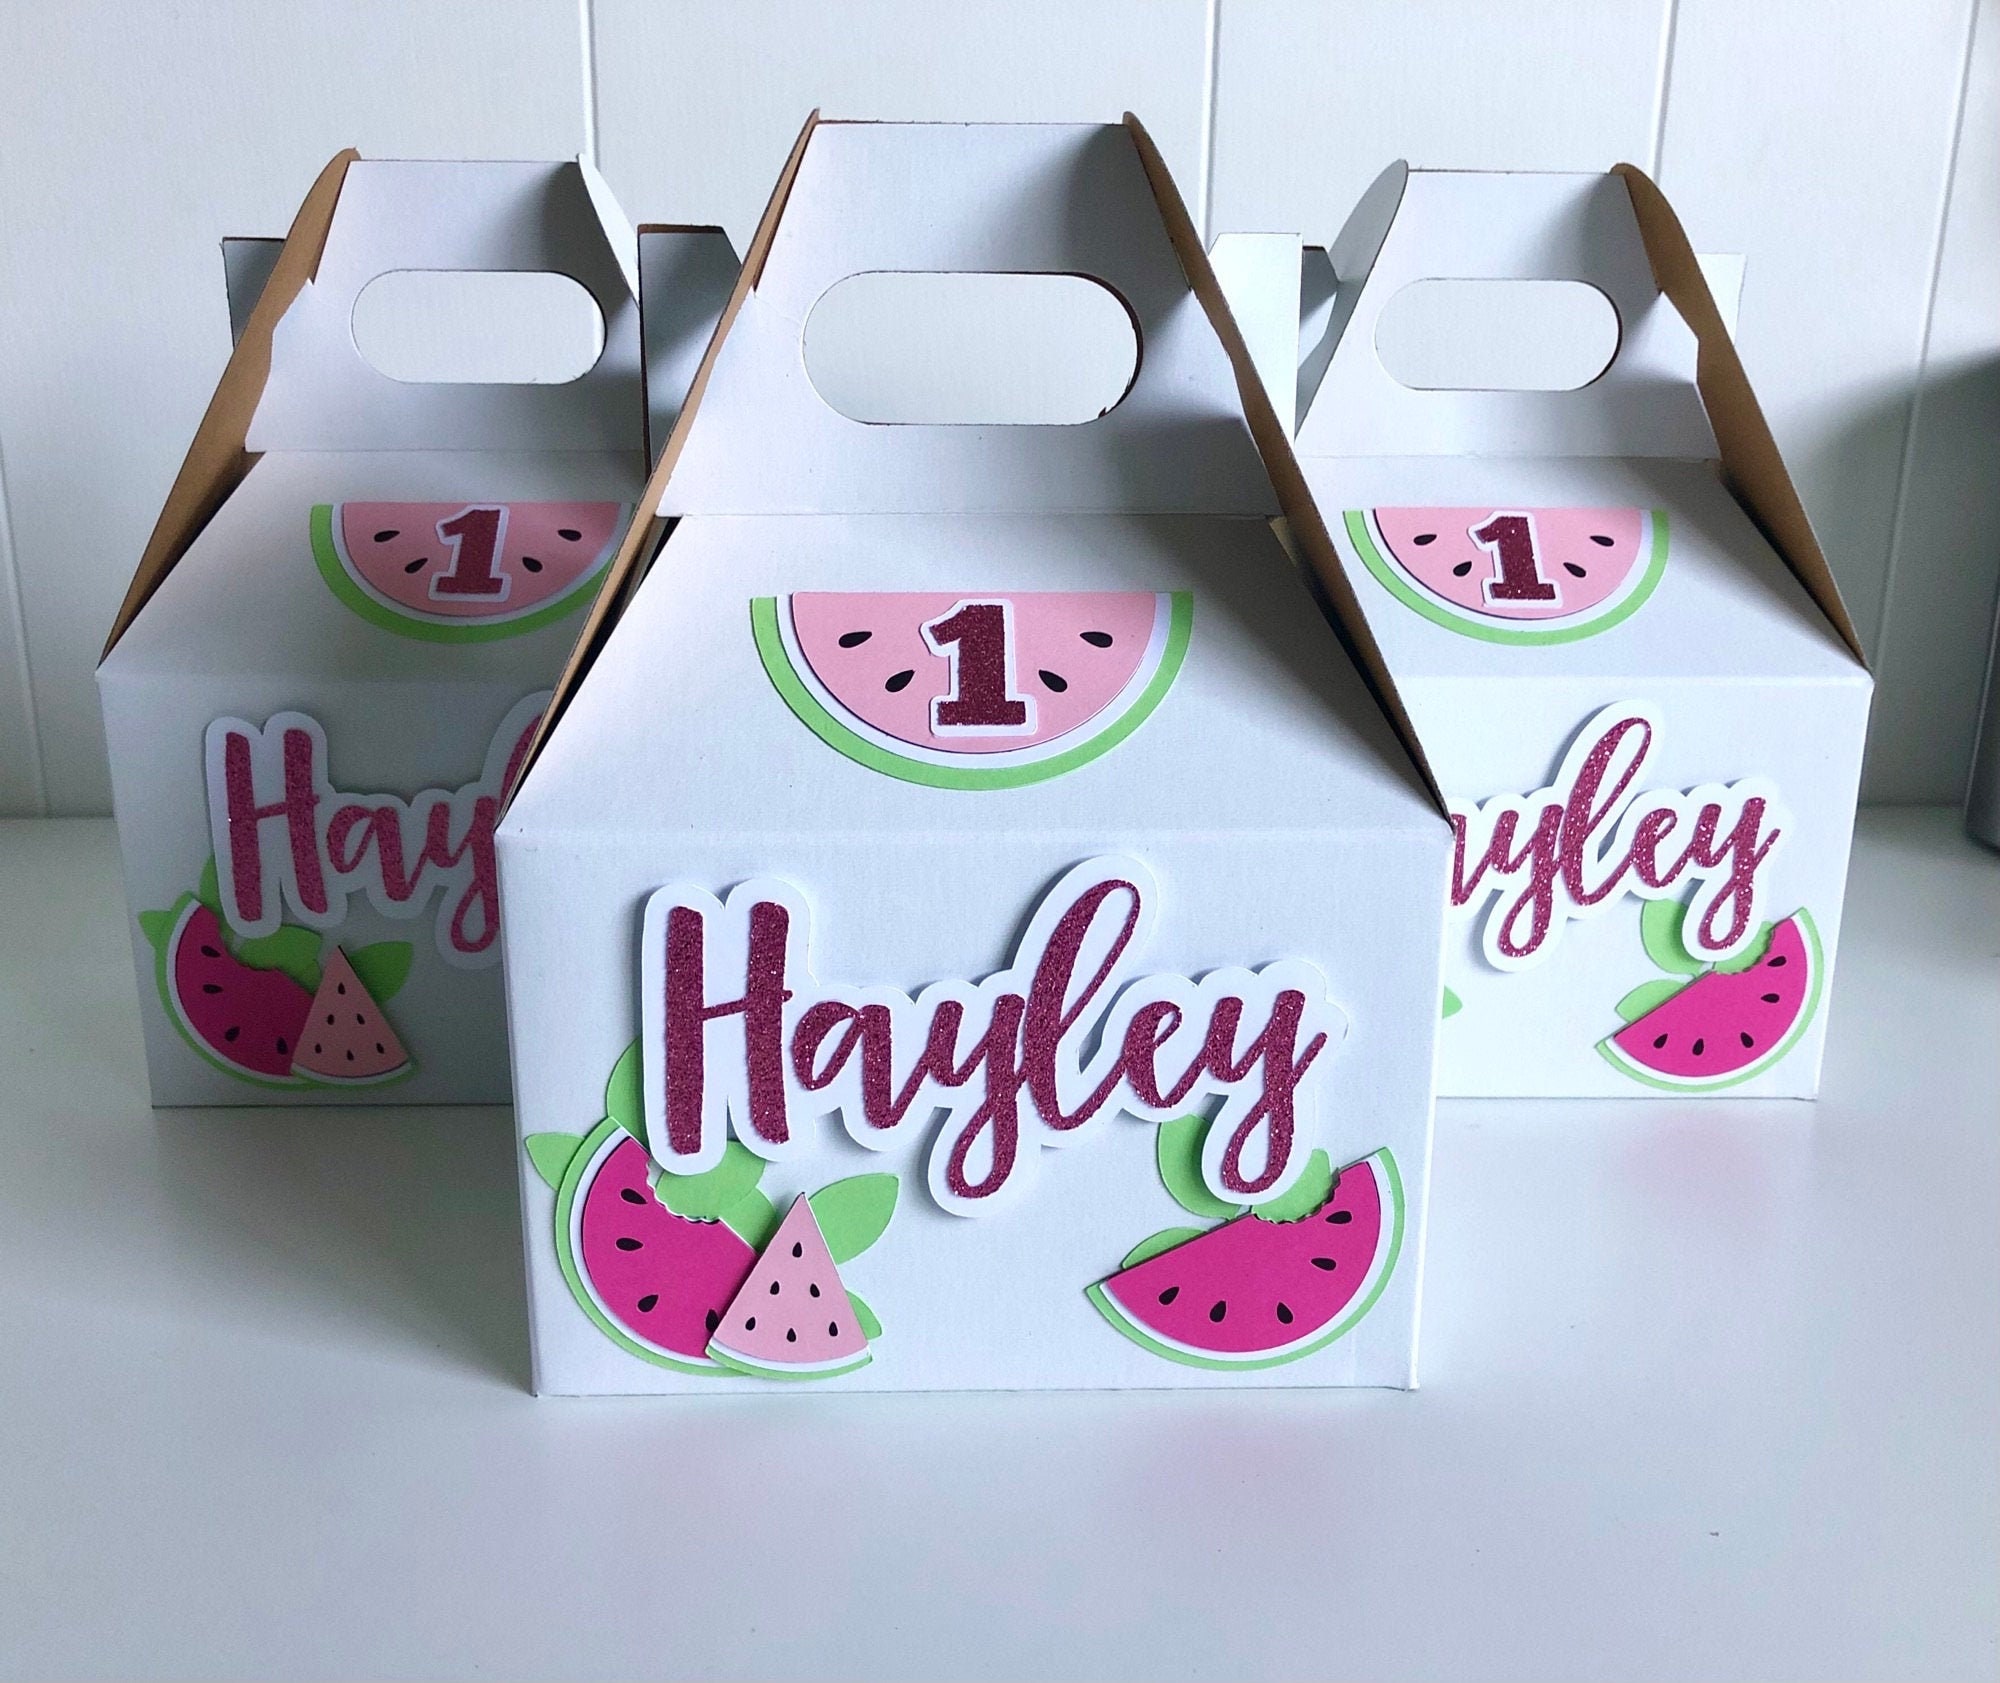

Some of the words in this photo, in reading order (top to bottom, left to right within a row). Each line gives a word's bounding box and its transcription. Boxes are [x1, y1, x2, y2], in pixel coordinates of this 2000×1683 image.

[436, 508, 504, 595] 1
[1474, 515, 1557, 601] 1
[928, 603, 1027, 726] 1
[664, 878, 1328, 1200] Hayley
